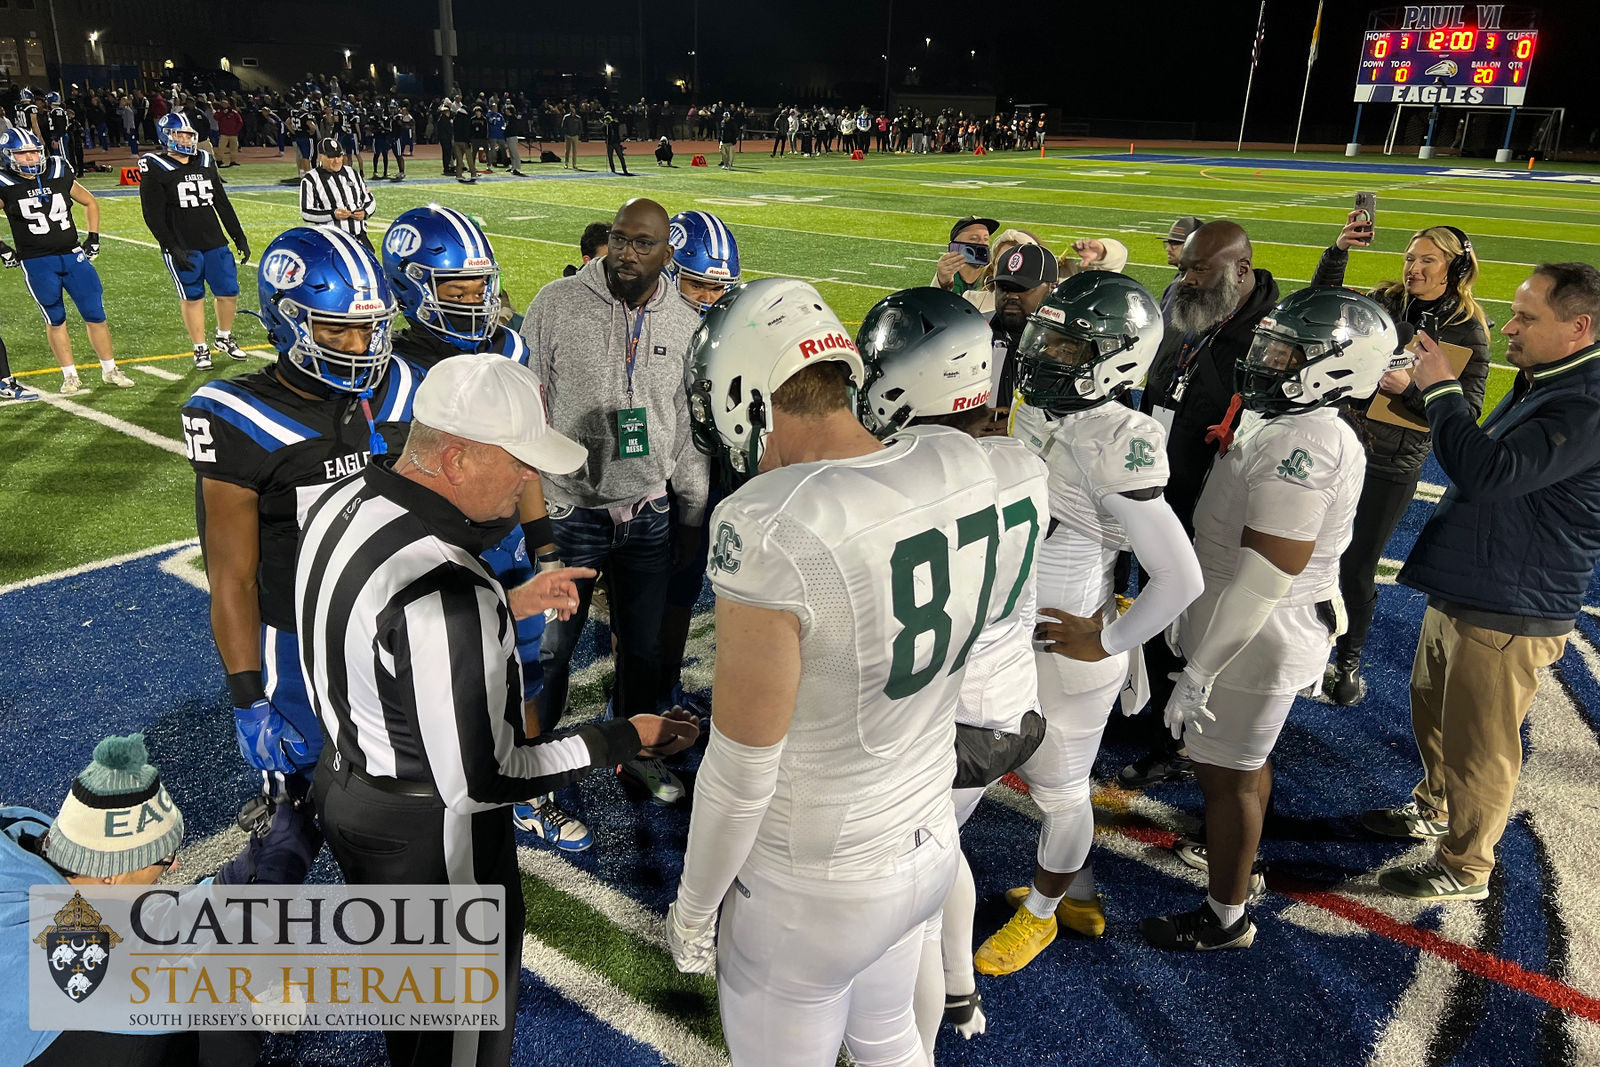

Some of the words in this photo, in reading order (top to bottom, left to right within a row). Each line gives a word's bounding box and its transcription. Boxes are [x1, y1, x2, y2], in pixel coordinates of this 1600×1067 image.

[1401, 5, 1465, 30] PAUL
[1476, 5, 1505, 29] VI
[1366, 32, 1391, 41] HOME
[1400, 37, 1409, 49] 3
[1428, 31, 1474, 50] 12:00
[1485, 37, 1495, 50] 3
[1506, 32, 1536, 41] GUEST
[1374, 40, 1388, 58] 0
[1516, 40, 1532, 59] 0
[1362, 60, 1385, 68] DOWN
[1400, 60, 1411, 68] GO
[1471, 61, 1488, 69] BALL
[1489, 61, 1501, 69] ON
[1507, 61, 1523, 70] QTR
[1371, 68, 1377, 81] 1
[1395, 67, 1408, 82] 10
[1473, 68, 1494, 84] 20
[1513, 70, 1520, 83] 1
[1390, 85, 1485, 104] EAGLES
[126, 169, 142, 183] 40
[27, 187, 52, 197] EAGES
[177, 180, 214, 208] 65
[17, 193, 71, 235] 54
[387, 227, 417, 252] PVI
[265, 253, 301, 283] PVI
[182, 413, 217, 463] 52
[628, 438, 639, 446] IKE
[625, 445, 644, 453] REESE
[883, 503, 1001, 701] 87
